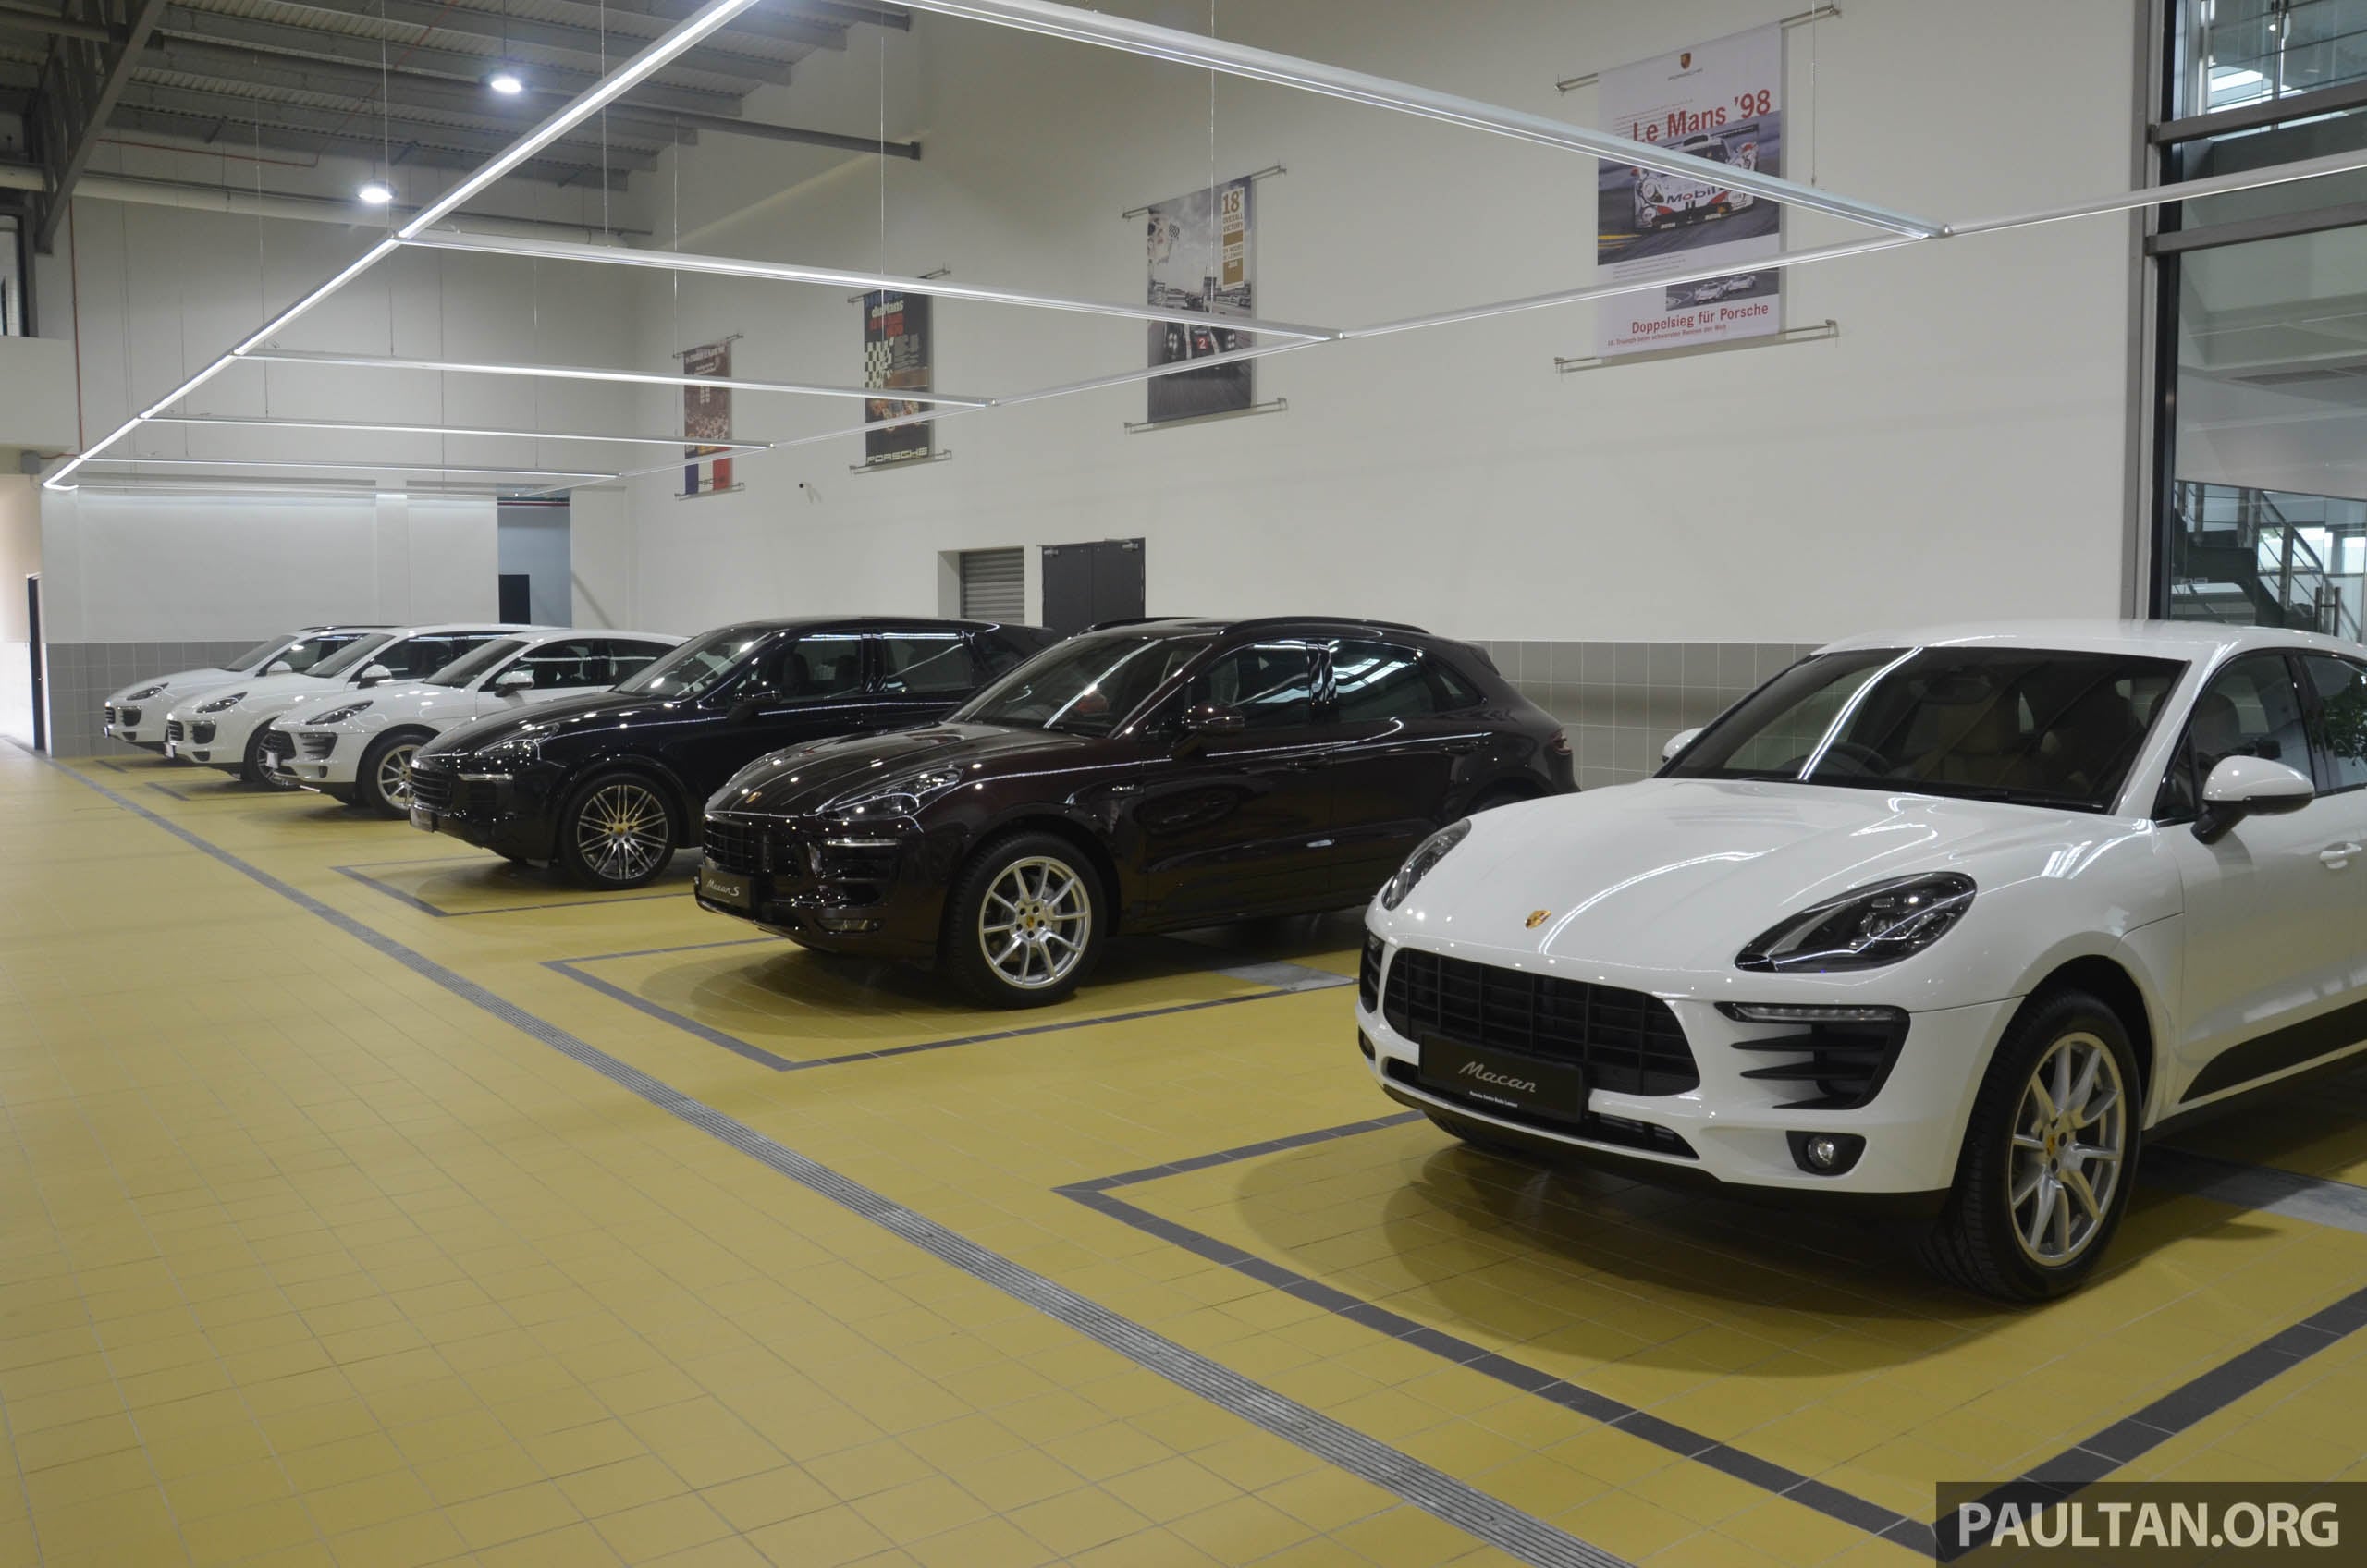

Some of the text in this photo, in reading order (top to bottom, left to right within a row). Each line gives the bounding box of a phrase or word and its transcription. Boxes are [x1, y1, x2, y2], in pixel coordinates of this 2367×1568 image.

[1633, 122, 1659, 142] Le
[1667, 106, 1726, 138] Mans
[1734, 89, 1771, 119] '98
[1632, 304, 1769, 335] Doppelsieg für Porsche
[1199, 338, 1206, 349] 2
[867, 447, 927, 463] PORSCHE
[706, 879, 740, 897] Macan S
[1458, 1060, 1537, 1093] Macan
